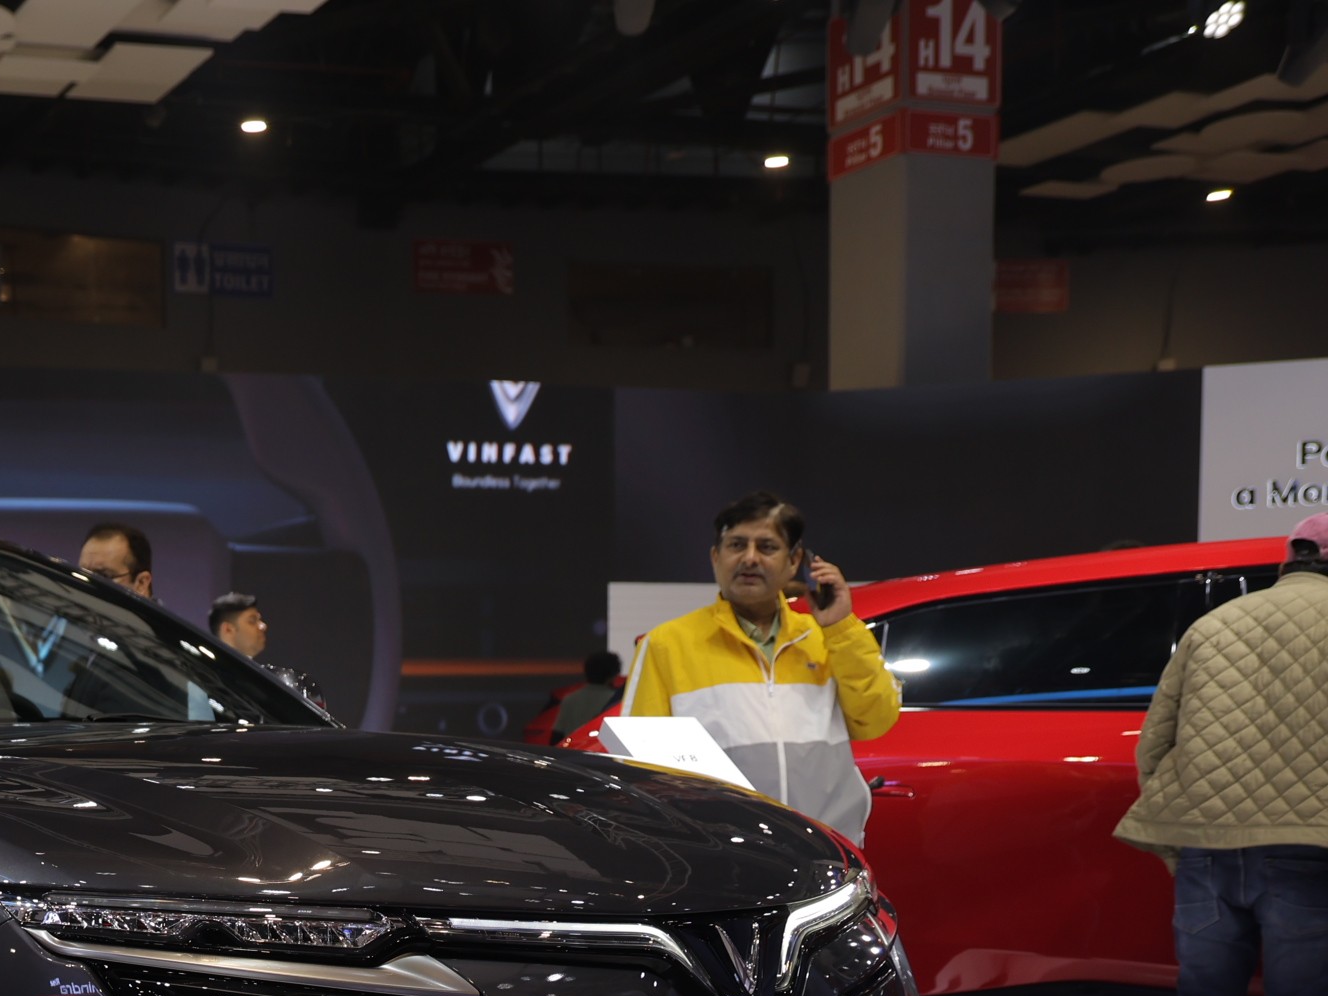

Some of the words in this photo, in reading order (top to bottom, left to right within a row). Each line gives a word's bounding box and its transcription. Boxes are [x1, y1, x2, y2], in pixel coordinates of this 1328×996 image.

[918, 0, 992, 72] H14
[868, 123, 884, 159] 5
[957, 118, 974, 151] 5
[446, 441, 572, 466] VINFAST
[1231, 485, 1257, 511] a
[1266, 477, 1328, 509] Mo
